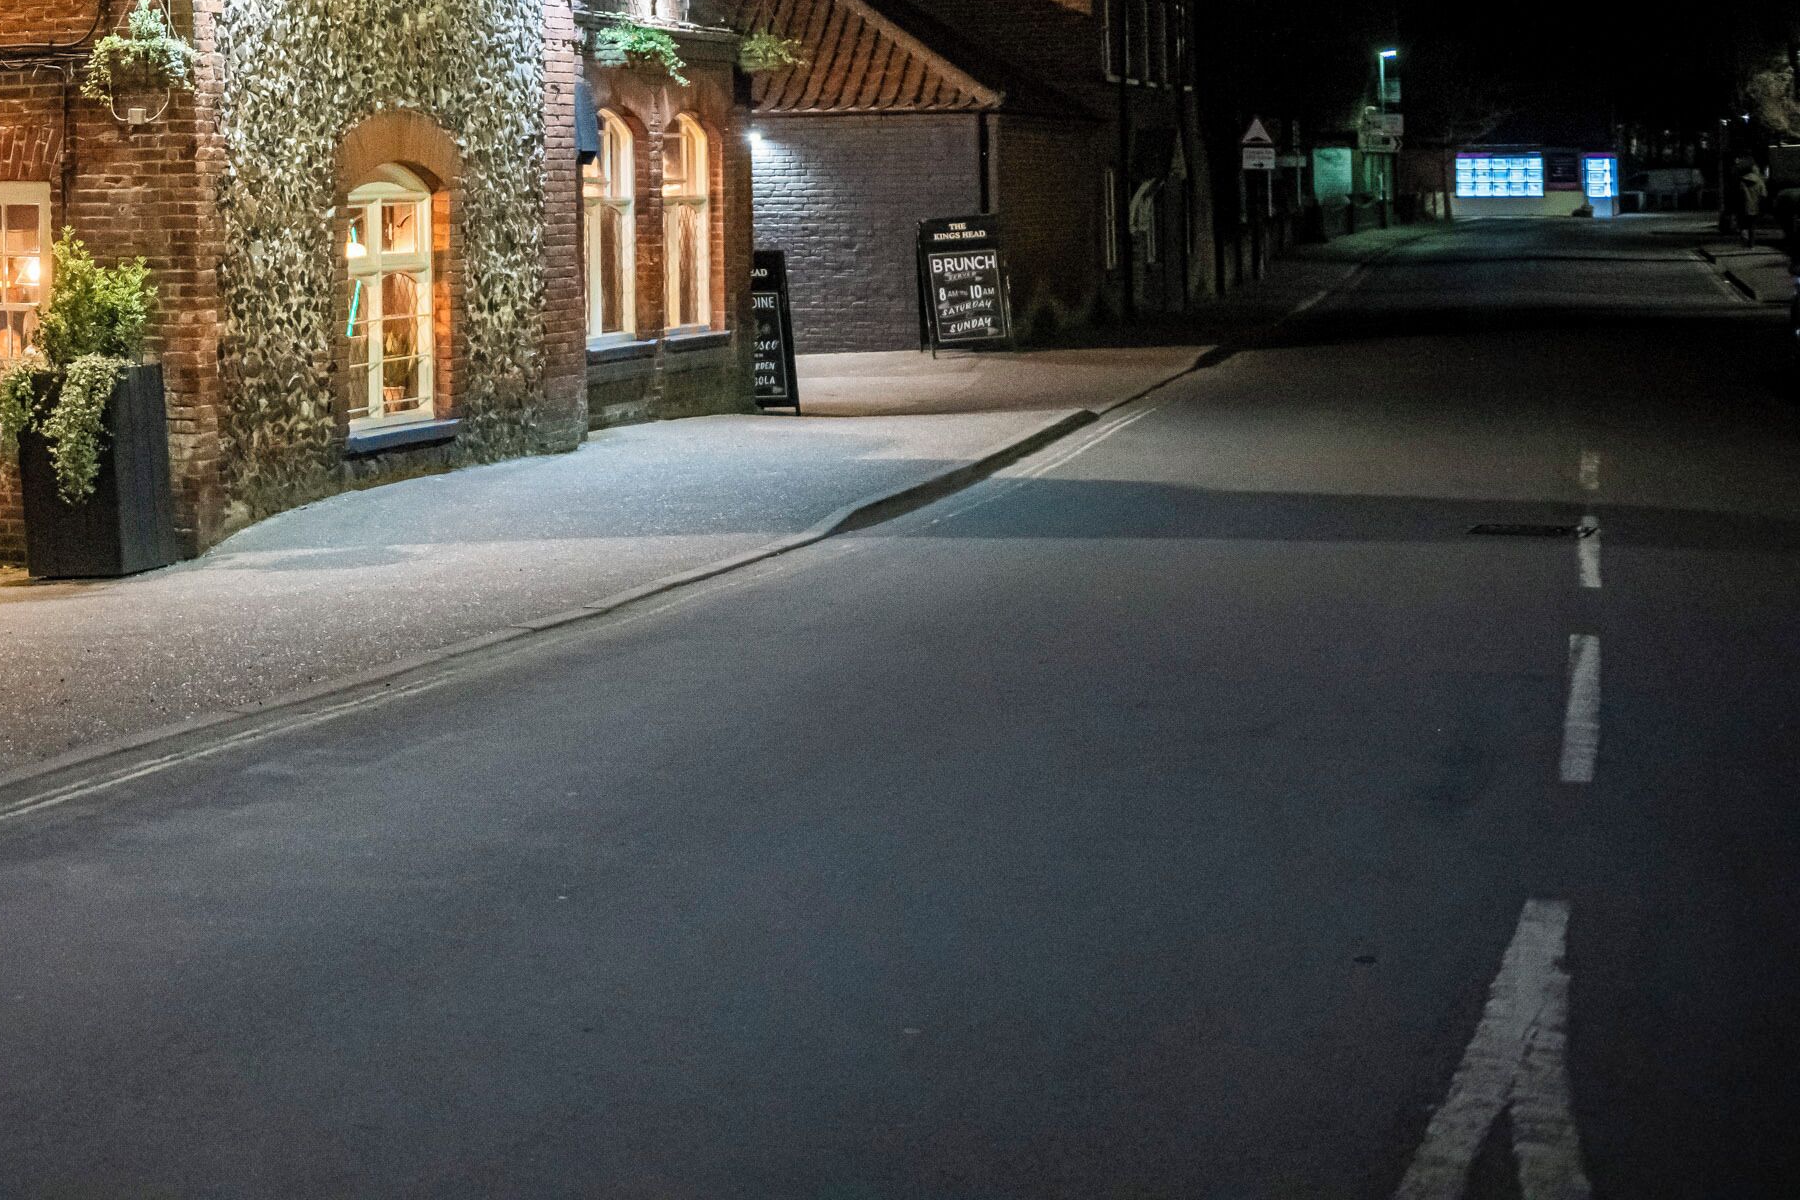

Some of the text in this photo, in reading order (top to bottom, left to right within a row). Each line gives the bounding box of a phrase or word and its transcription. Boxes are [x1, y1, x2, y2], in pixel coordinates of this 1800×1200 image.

[949, 222, 967, 231] THE
[934, 229, 986, 241] KINGS HEAD
[932, 255, 996, 273] BRUNCH
[942, 300, 992, 316] SATURDAY
[949, 317, 992, 333] SUNDAY
